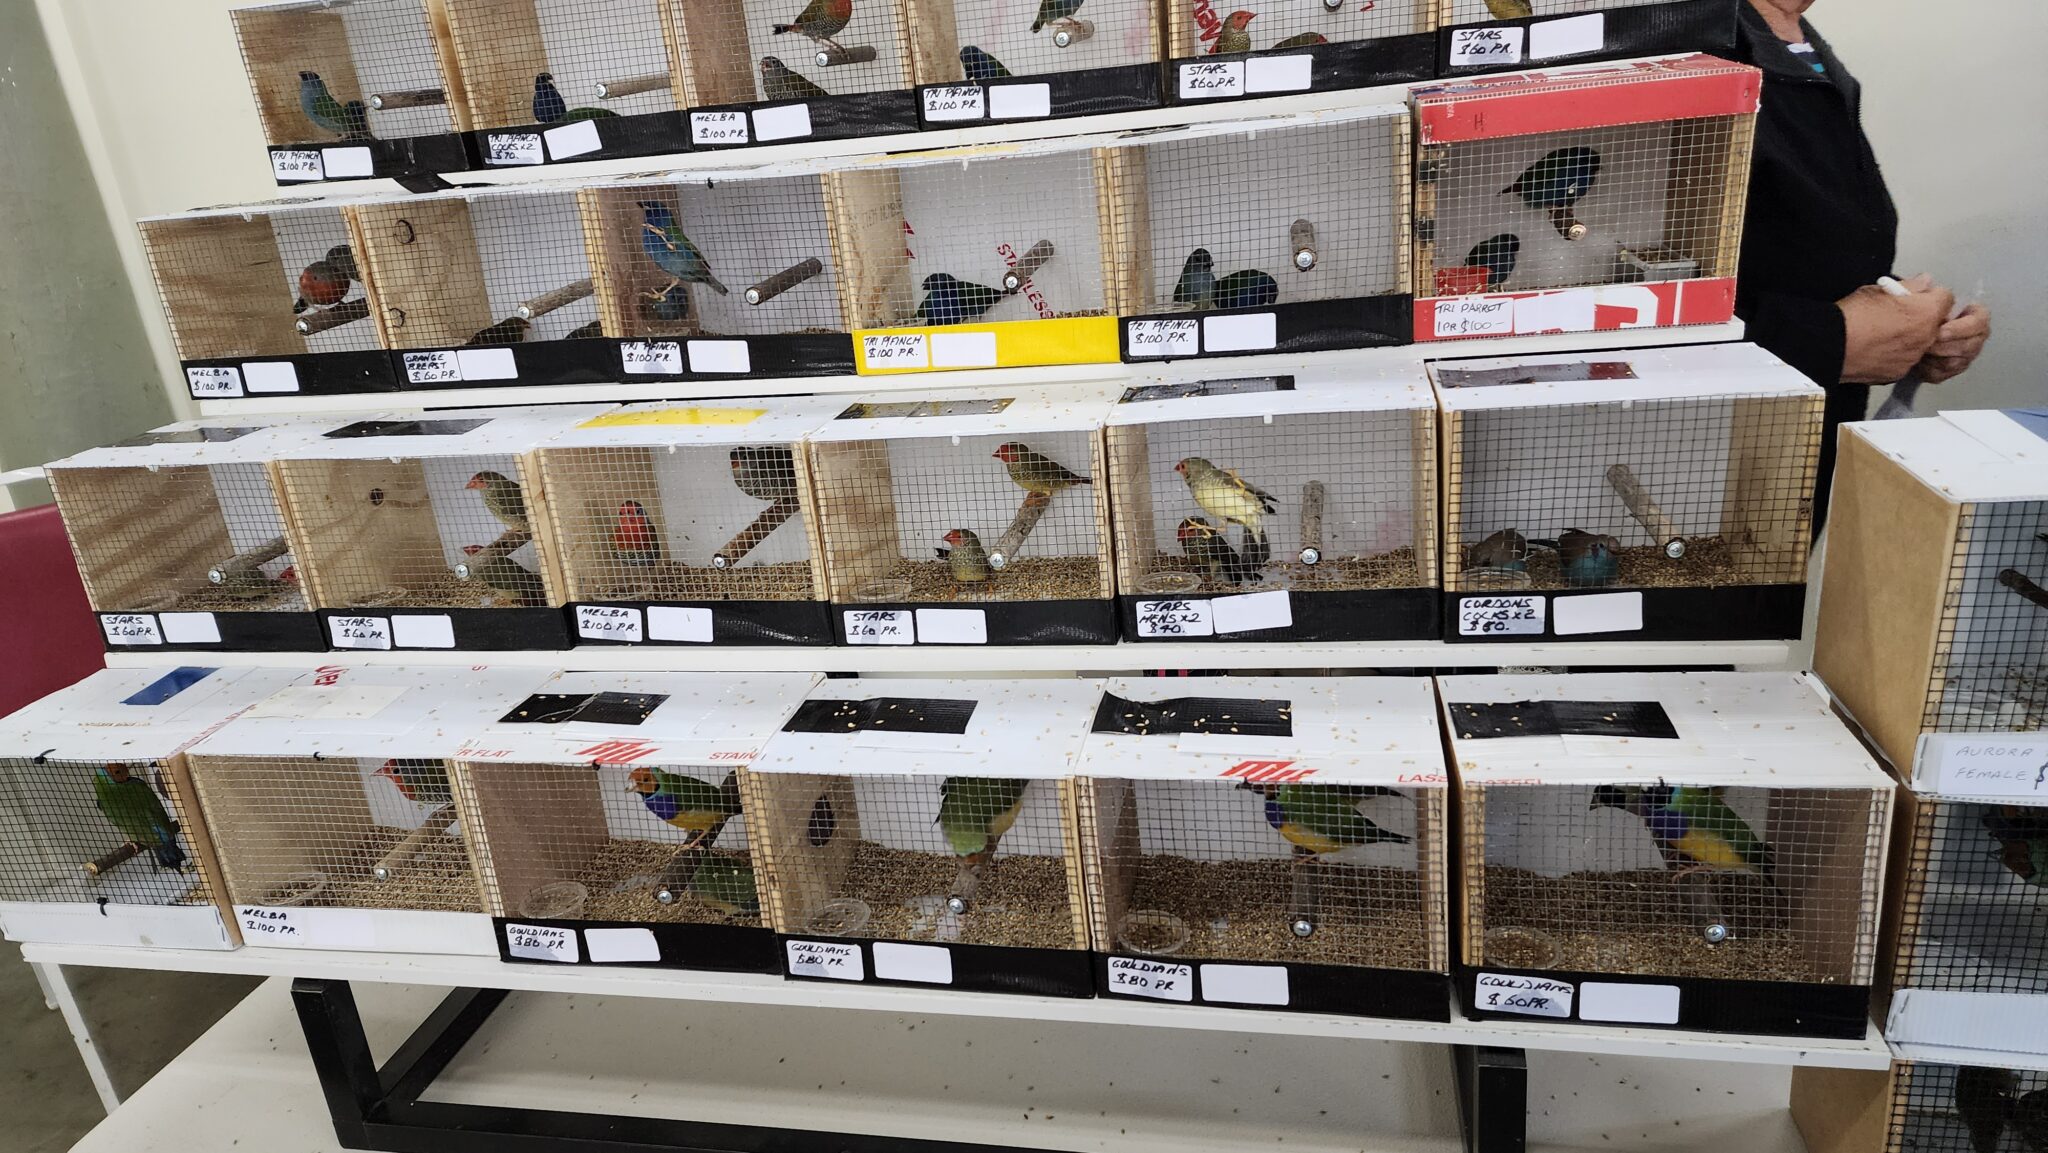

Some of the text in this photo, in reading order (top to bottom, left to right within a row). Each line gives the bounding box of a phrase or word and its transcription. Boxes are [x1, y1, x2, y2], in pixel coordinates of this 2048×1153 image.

[1456, 30, 1503, 41] STARS
[1188, 64, 1228, 75] STARS
[925, 89, 940, 98] TRI
[926, 100, 957, 111] $100
[695, 113, 736, 121] MELBA
[490, 134, 502, 142] TRI
[699, 129, 726, 139] $100
[272, 152, 287, 160] TRI
[278, 162, 299, 171] $100
[1433, 301, 1508, 313] TRI PARROT
[1129, 321, 1147, 330] TRI
[863, 337, 878, 346] TRI
[1133, 333, 1163, 343] $100
[405, 353, 445, 363] ORANGE
[624, 353, 652, 362] $100
[867, 349, 893, 358] $100
[190, 368, 230, 377] MELBA
[193, 381, 215, 391] $100
[1144, 601, 1192, 612] STARS
[1463, 599, 1532, 608] CORDONS
[581, 608, 629, 618] MELBA
[852, 611, 896, 621] STARS
[1462, 610, 1510, 620] COCKS
[105, 616, 145, 624] STARS
[336, 618, 374, 627] STARS
[1139, 613, 1177, 624] HENS
[581, 620, 612, 631] $100
[848, 625, 876, 636] $60
[341, 629, 366, 638] $60
[471, 750, 515, 758] FLAT
[1955, 745, 2033, 757] AURORA
[1956, 766, 2027, 780] FEMALE
[242, 908, 287, 920] MELBA
[246, 921, 275, 933] $100
[509, 927, 565, 938] GOULDIANS
[513, 936, 565, 950] $80 PR
[791, 943, 851, 956] GOULDIANS
[797, 955, 844, 967] $80 PR
[1111, 958, 1188, 976] GOULDIANS
[1111, 972, 1175, 990] $80 PR
[1479, 976, 1571, 994] GOULDIANS
